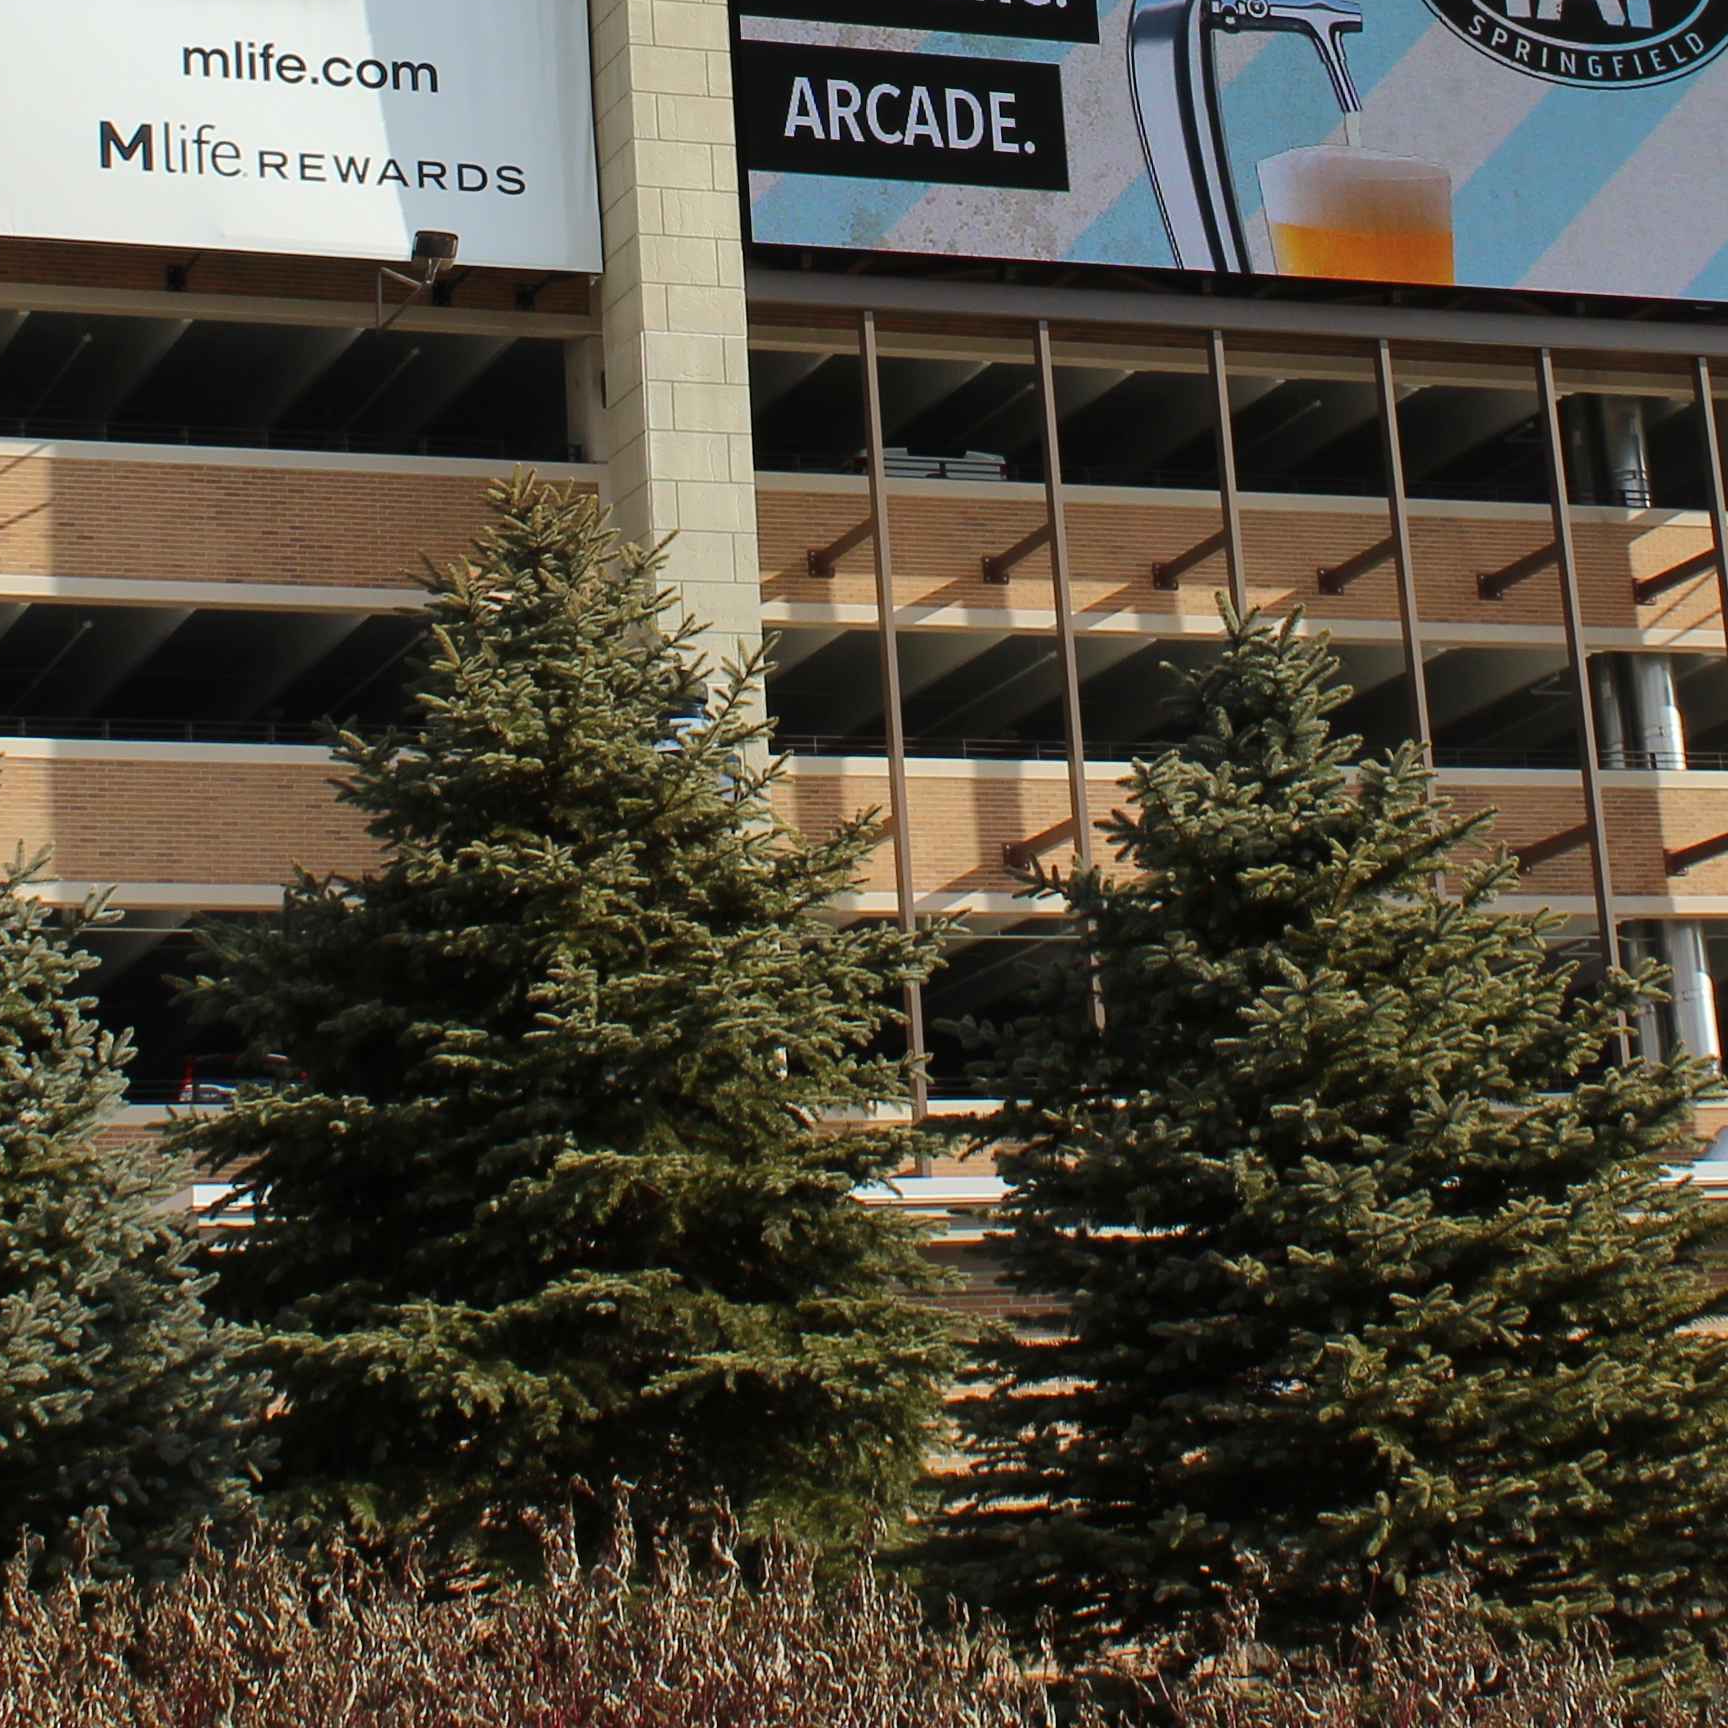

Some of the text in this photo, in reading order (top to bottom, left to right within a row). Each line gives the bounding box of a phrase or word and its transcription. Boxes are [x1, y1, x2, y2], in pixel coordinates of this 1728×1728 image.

[183, 41, 439, 93] mlife.com
[1467, 14, 1704, 79] SPRINGFIELD
[783, 76, 1037, 156] ARCADE.
[258, 150, 527, 196] REWARDS
